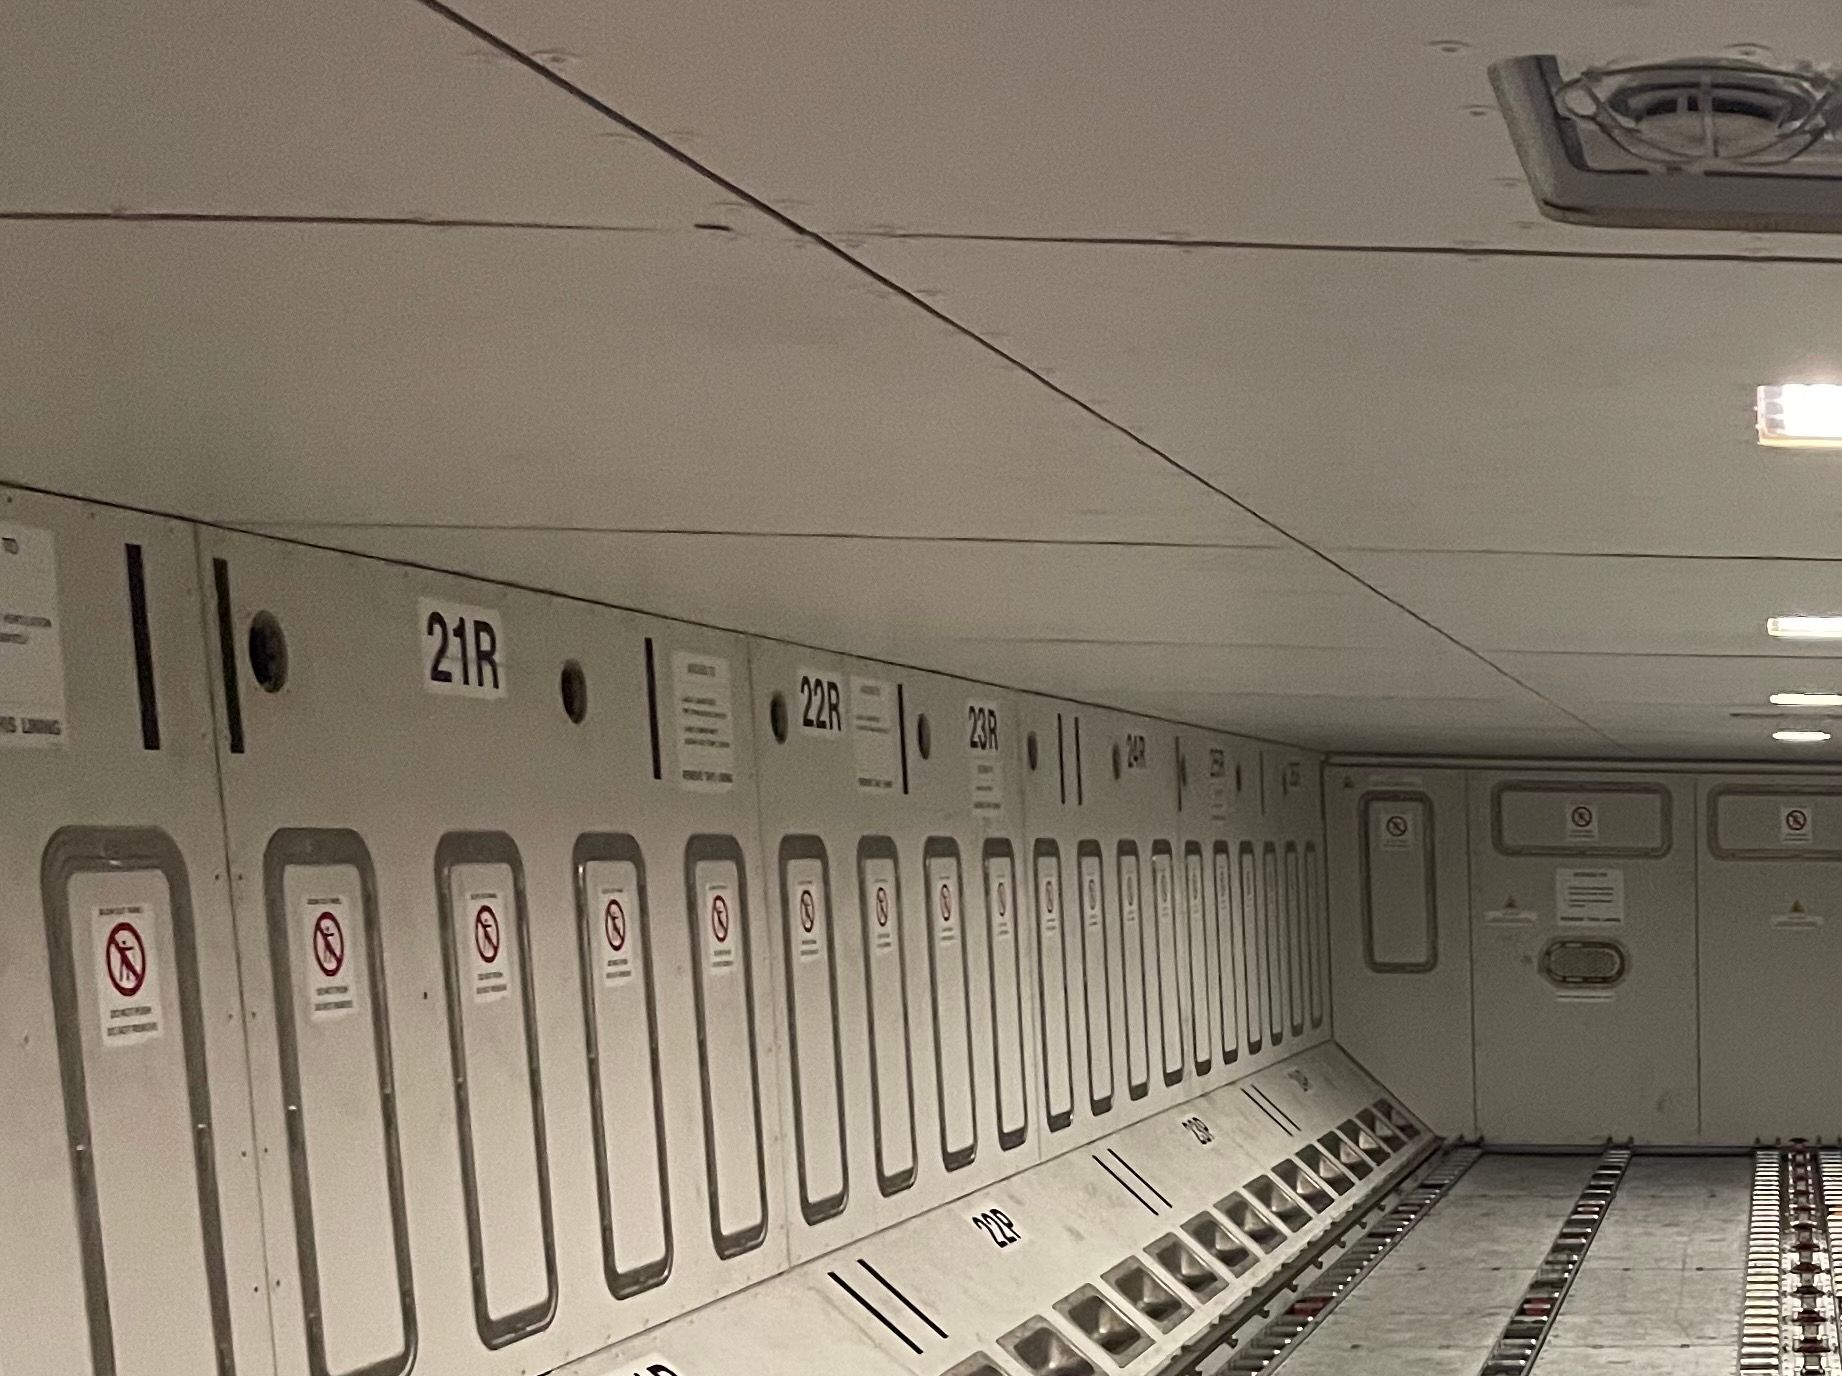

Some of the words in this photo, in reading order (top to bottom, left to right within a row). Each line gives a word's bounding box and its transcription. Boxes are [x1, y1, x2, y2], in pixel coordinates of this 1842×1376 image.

[427, 611, 499, 689] 21R
[801, 676, 841, 731] 22R
[968, 706, 999, 750] 23R
[972, 1208, 1022, 1249] 22P
